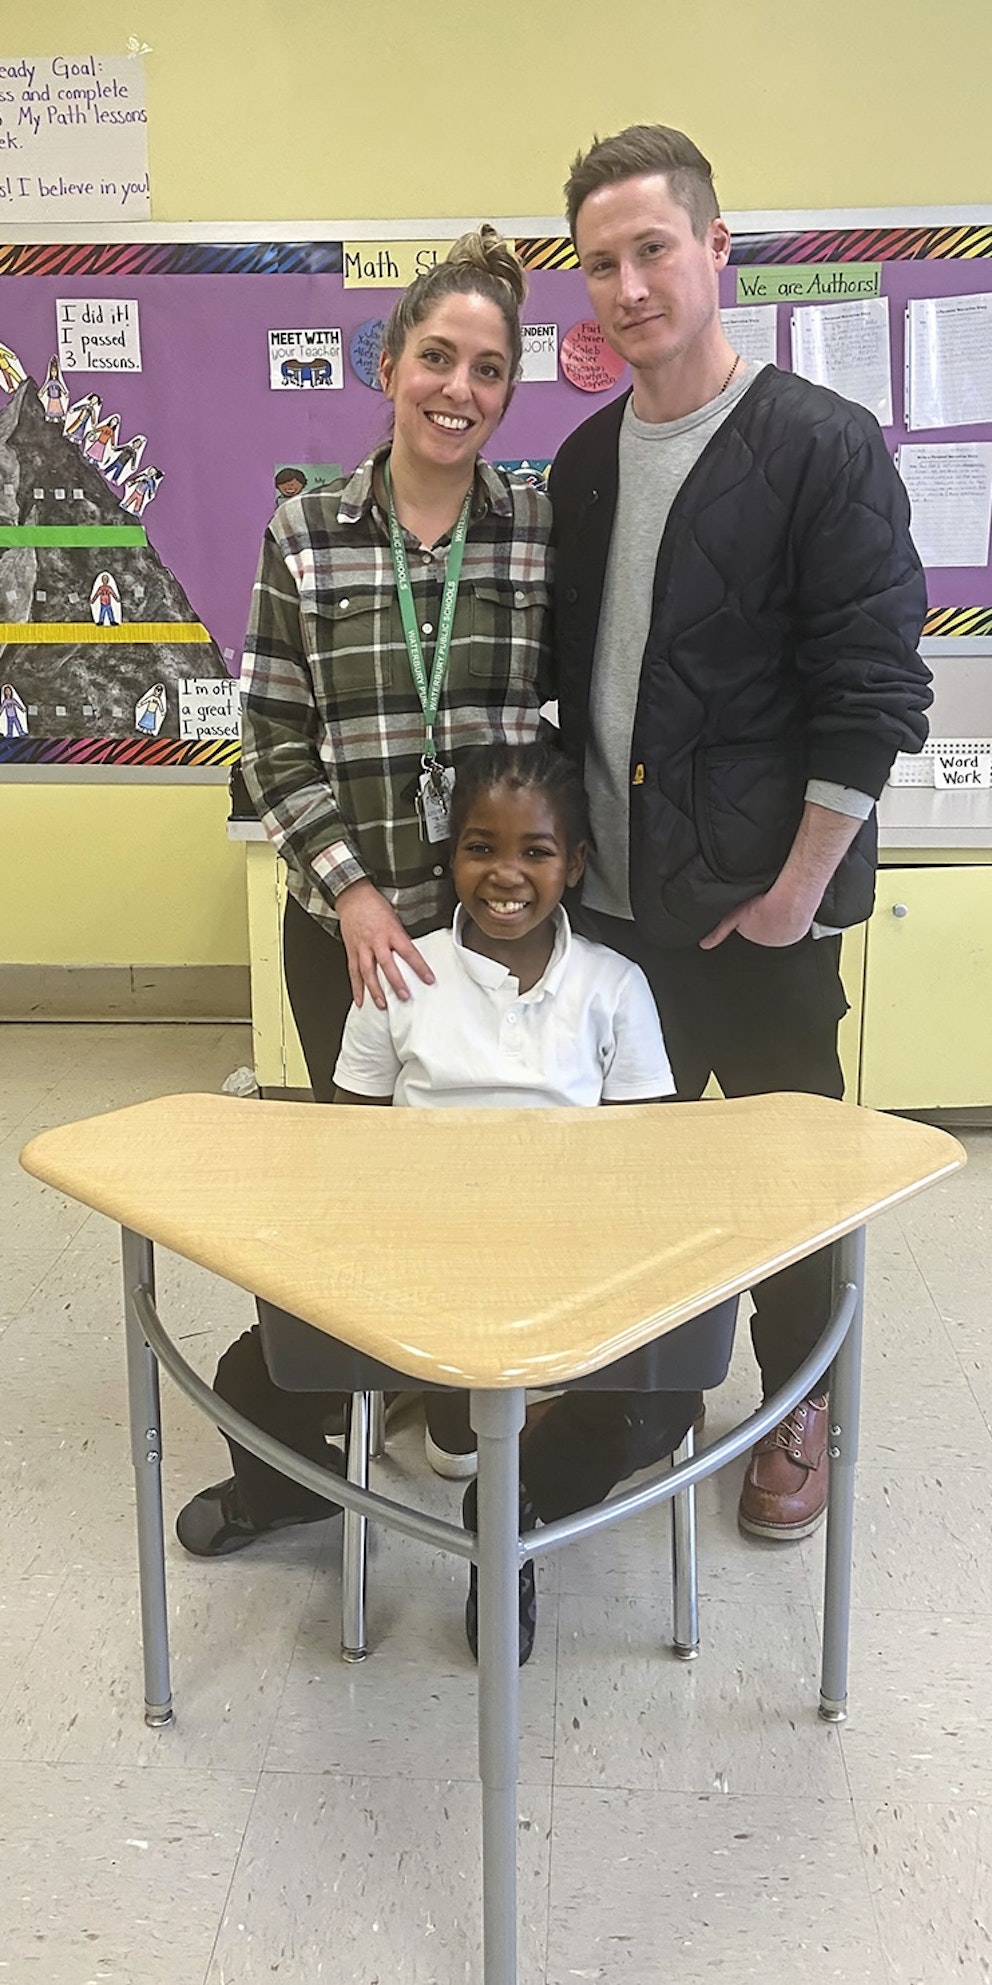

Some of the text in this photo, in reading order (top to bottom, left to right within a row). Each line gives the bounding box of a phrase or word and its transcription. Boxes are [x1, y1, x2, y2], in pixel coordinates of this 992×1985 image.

[52, 56, 103, 79] Goal:
[21, 83, 50, 101] and
[57, 78, 129, 110] complete
[18, 106, 41, 135] My
[47, 104, 87, 125] Path
[94, 103, 148, 124] lessons
[17, 177, 31, 197] I
[38, 177, 94, 197] believe
[101, 178, 117, 195] in
[121, 173, 150, 205] you!
[345, 250, 399, 279] Math
[739, 271, 879, 297] We are Authors!
[61, 303, 130, 327] I did it!
[61, 327, 126, 354] I passed
[271, 331, 339, 346] MEET WITH
[65, 350, 140, 369] 3 lessons.
[271, 344, 340, 361] your Teacher
[394, 549, 409, 591] SCHOOLS
[407, 629, 425, 685] WATERBURY
[430, 580, 457, 711] WATERBURY PUBLIC SCHOOLS
[182, 678, 238, 696] I'm off
[181, 706, 191, 716] a
[197, 698, 232, 722] great
[182, 719, 239, 740] I passed
[939, 755, 979, 769] Word
[942, 770, 982, 785] Work
